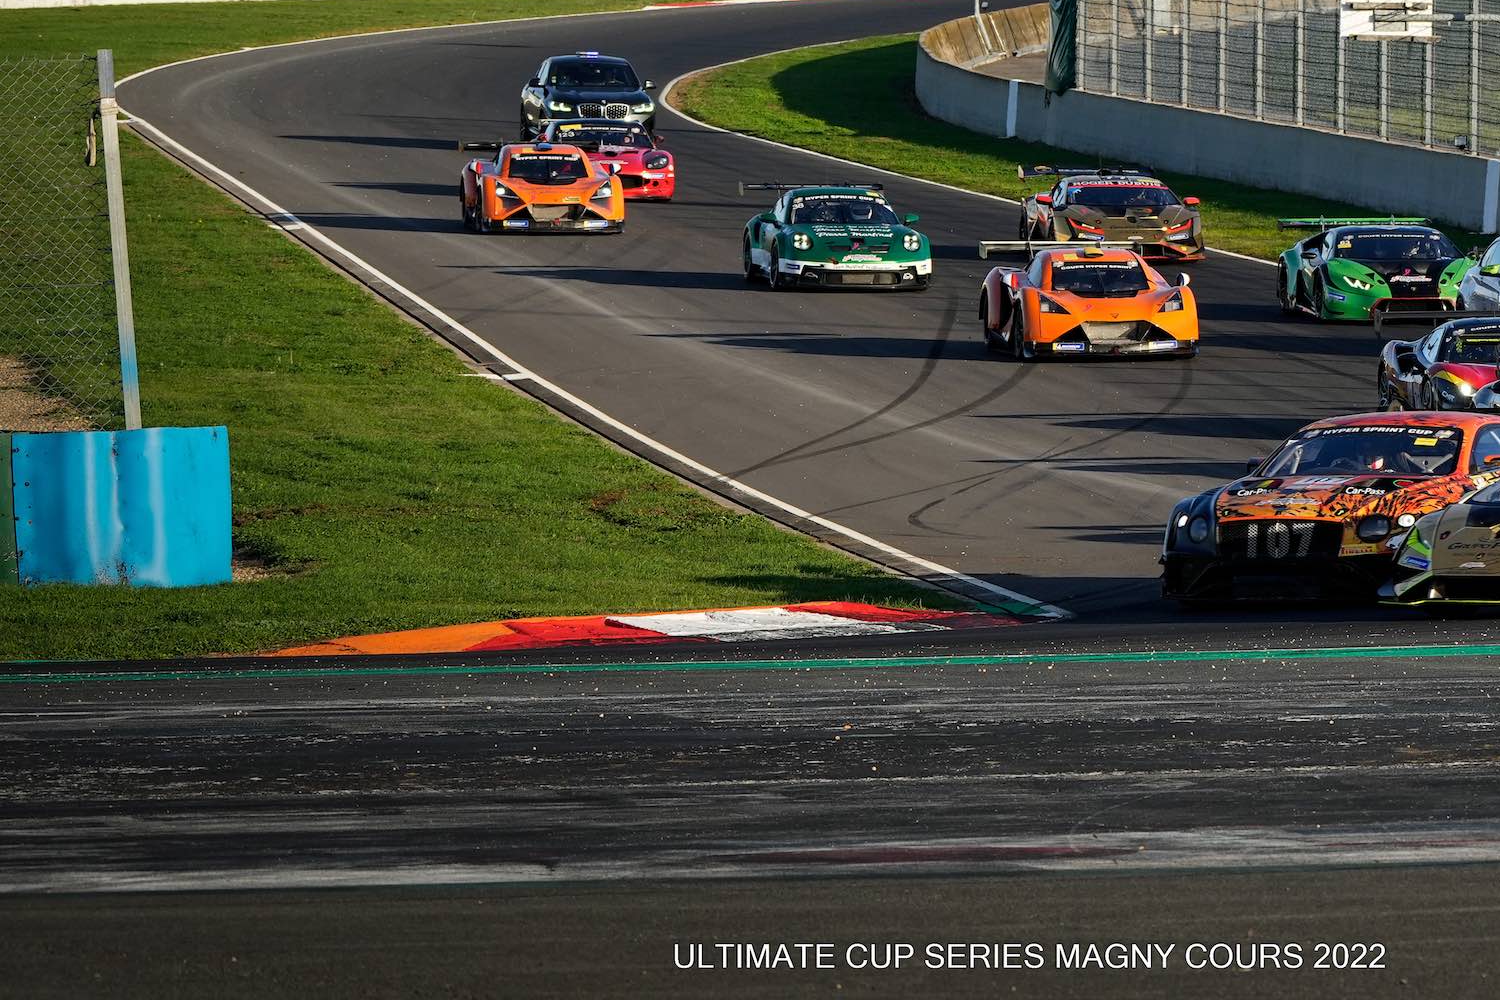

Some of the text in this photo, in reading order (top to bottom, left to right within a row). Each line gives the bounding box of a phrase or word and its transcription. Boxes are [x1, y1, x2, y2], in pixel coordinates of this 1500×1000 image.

[1322, 426, 1434, 436] HYPER SPRINT CUP
[1237, 488, 1280, 497] Car-Pass
[1345, 486, 1386, 495] Car-Pass
[1248, 522, 1316, 559] 107
